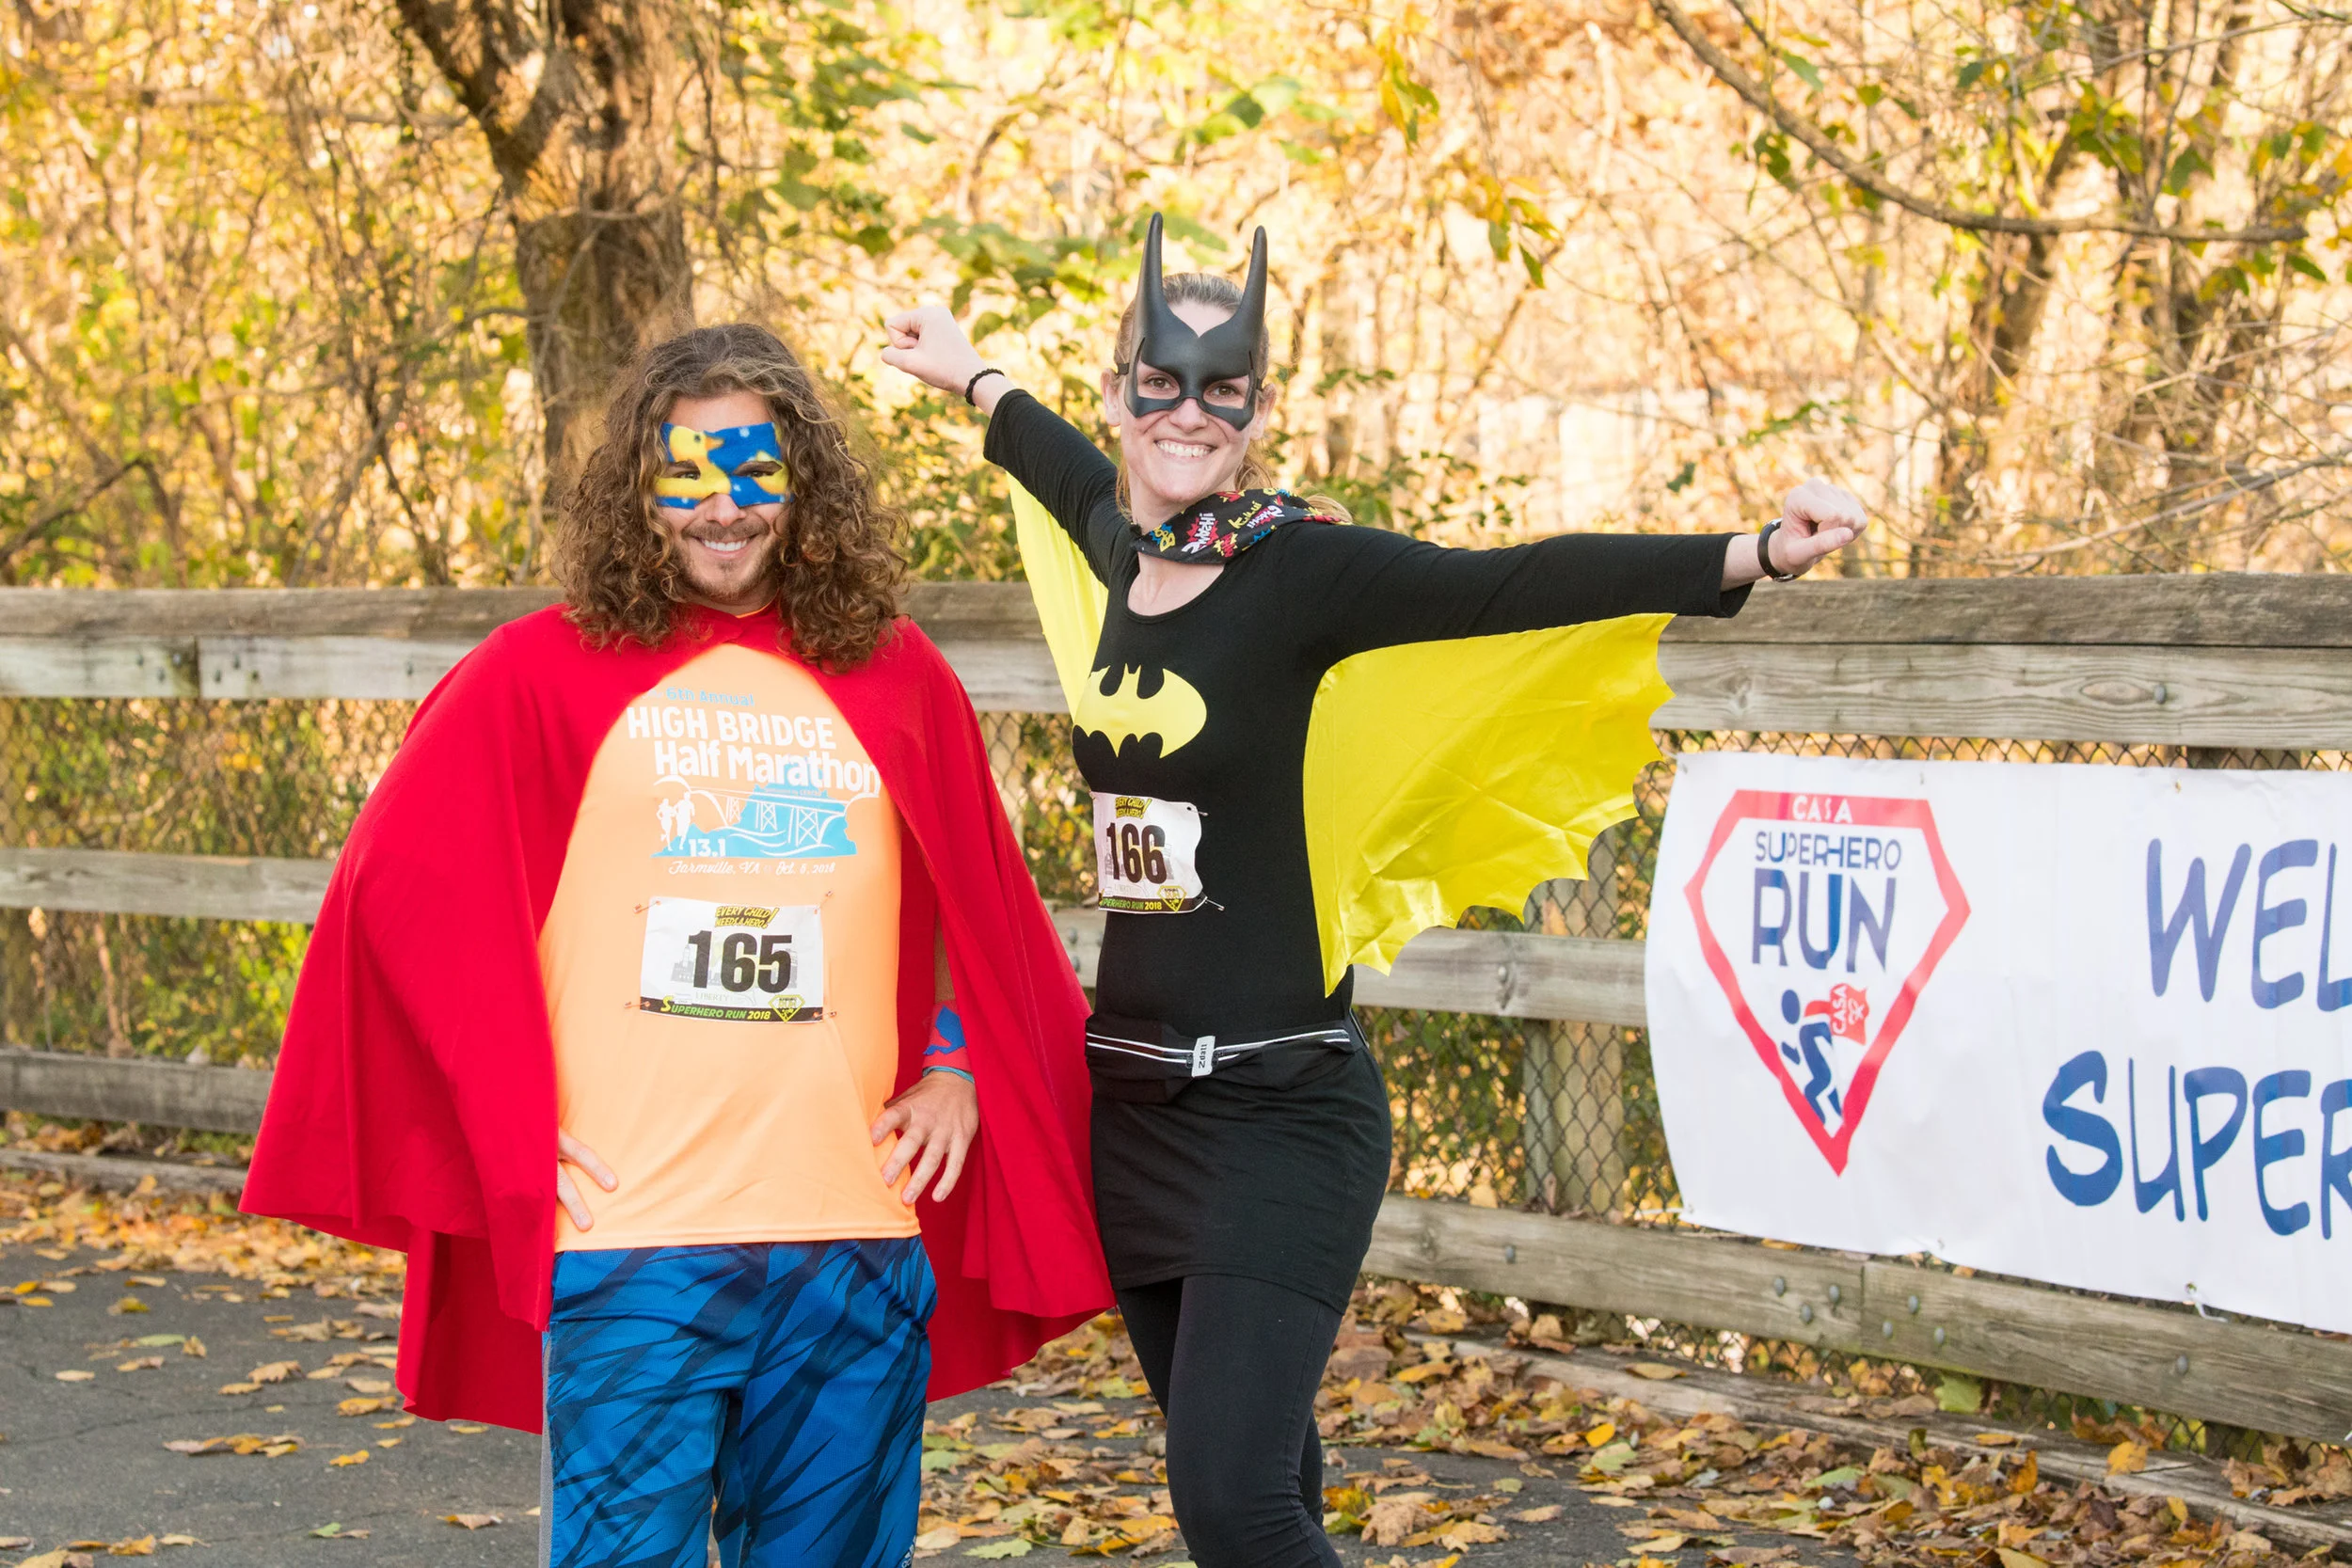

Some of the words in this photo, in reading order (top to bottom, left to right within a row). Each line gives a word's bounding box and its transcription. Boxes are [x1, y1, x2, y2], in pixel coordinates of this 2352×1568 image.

[666, 687, 695, 701] 6th
[699, 689, 755, 705] Annual
[627, 705, 709, 739] HIGH
[716, 709, 837, 750] BRIDGE
[654, 739, 721, 778] Half
[727, 744, 882, 798] Marathon
[1792, 796, 1852, 824] CASA
[688, 838, 726, 858] 13.1
[1106, 822, 1167, 884] 166
[1755, 831, 1901, 870] SUPERHERO
[739, 861, 760, 874] VA
[716, 906, 745, 917] EVERY
[744, 907, 771, 918] CHILD
[1144, 901, 1162, 910] 2018
[715, 917, 739, 927] NEEDS
[1752, 867, 1897, 974] RUN
[688, 930, 792, 993] 165
[660, 994, 724, 1018] SUPERHERO
[724, 1009, 747, 1020] RUN
[747, 1009, 771, 1021] 2018
[1833, 984, 1848, 1035] CASA
